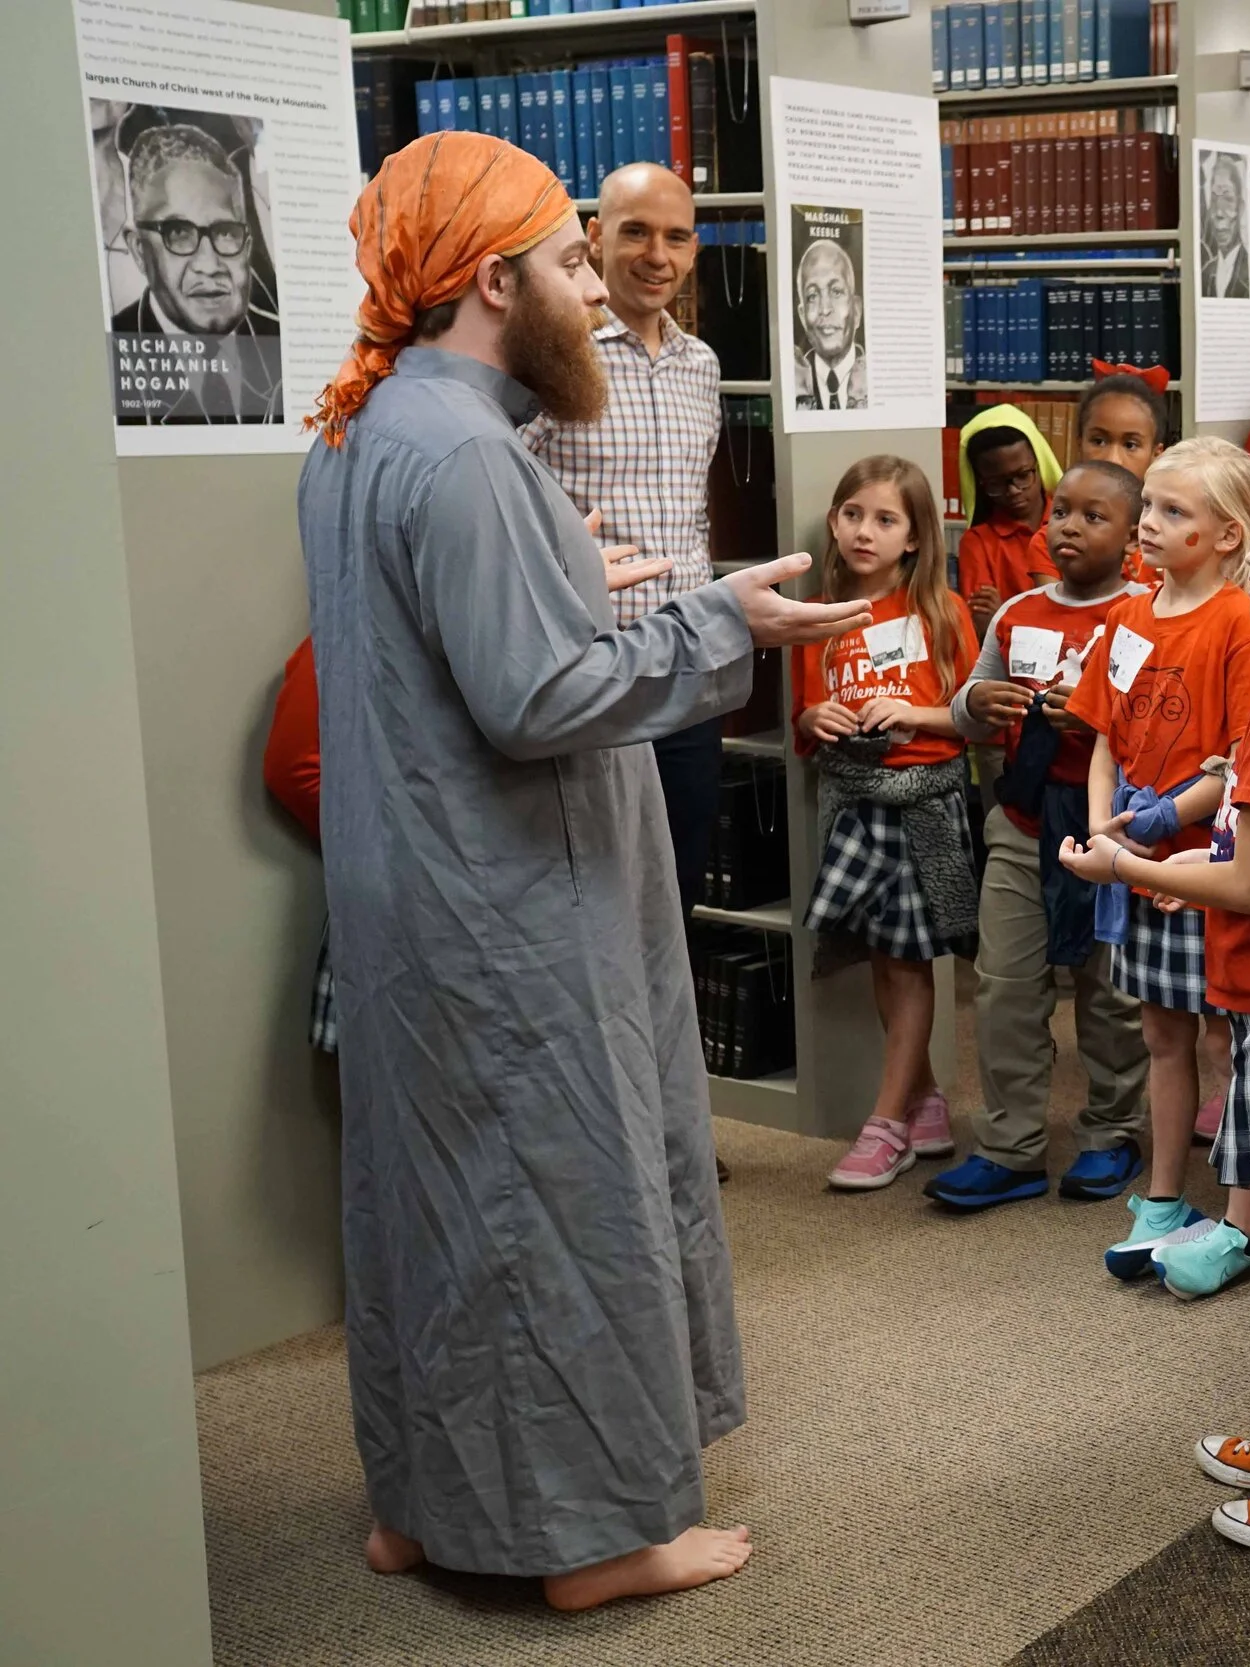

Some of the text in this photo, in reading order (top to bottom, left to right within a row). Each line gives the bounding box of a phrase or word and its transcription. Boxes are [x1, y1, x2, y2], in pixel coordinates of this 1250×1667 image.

[86, 71, 329, 110] largest Church of Christ west of the Rocky Mountains.
[804, 211, 850, 225] MARSHALL
[809, 226, 841, 239] KEEBLE
[119, 339, 205, 354] RICHARD
[120, 357, 230, 373] NATHANIEL
[120, 376, 190, 390] HOGAN
[121, 399, 162, 409] 1902-1997
[841, 680, 913, 703] Memphis
